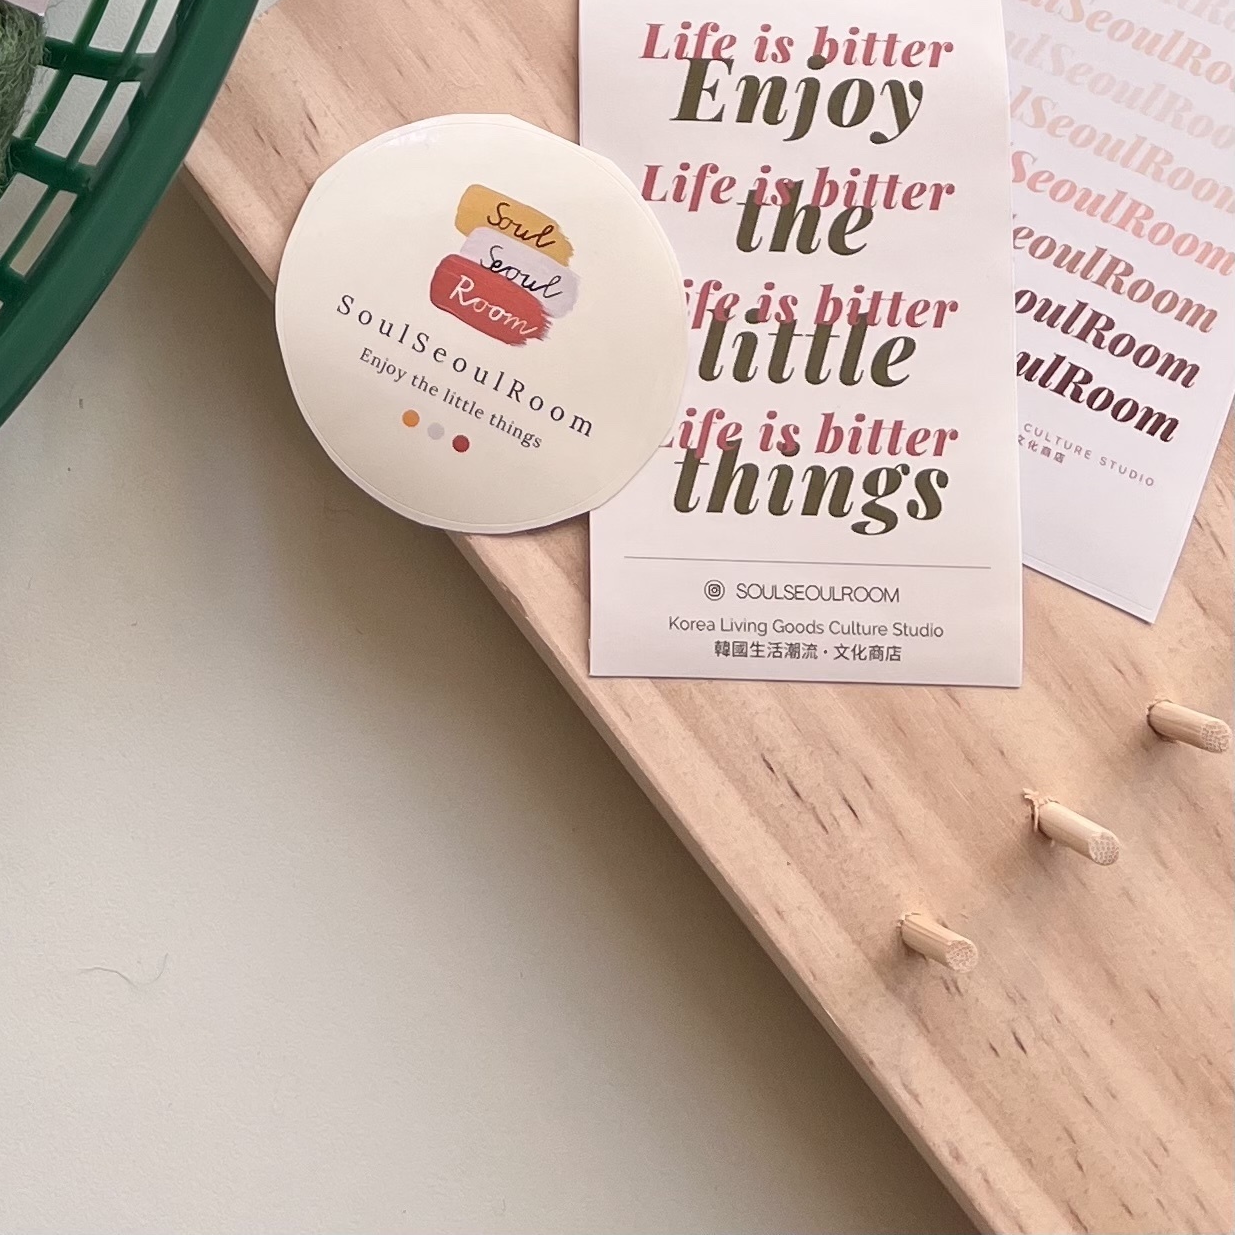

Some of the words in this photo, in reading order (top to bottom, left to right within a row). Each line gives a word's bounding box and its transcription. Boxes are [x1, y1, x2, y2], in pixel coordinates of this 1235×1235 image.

[639, 21, 736, 62] Life
[754, 24, 794, 63] is
[814, 25, 954, 68] bitter
[669, 53, 924, 145] Enjoy
[641, 162, 736, 212] Life
[753, 165, 795, 207] is
[810, 166, 955, 211] bitter
[735, 180, 874, 255] the
[1011, 150, 1235, 276] SeoulRoom
[486, 201, 556, 248] Soul
[449, 275, 538, 335] Room
[480, 245, 563, 299] Seoul
[683, 279, 740, 329] ife
[756, 282, 798, 325] is
[815, 284, 959, 329] bitter
[1013, 214, 1218, 334] eoulRoom
[336, 294, 594, 438] SoulSeoulRoom
[697, 307, 918, 387] little
[1015, 289, 1201, 389] oulRoom
[359, 347, 407, 383] Enjoy
[411, 373, 440, 398] the
[443, 389, 484, 420] little
[489, 411, 542, 449] things
[1016, 351, 1180, 443] ulRoom
[659, 407, 743, 459] ife
[759, 410, 800, 455] is
[815, 412, 959, 457] bitter
[1024, 423, 1092, 460] CULTURE
[1099, 456, 1155, 486] STUDIO
[672, 438, 949, 536] things
[668, 616, 715, 632] Korea
[720, 617, 768, 636] Living
[772, 619, 825, 635] Goods
[828, 620, 888, 637] Culture
[892, 622, 944, 638] Studio
[736, 583, 900, 603] SOULSEOULROOM
